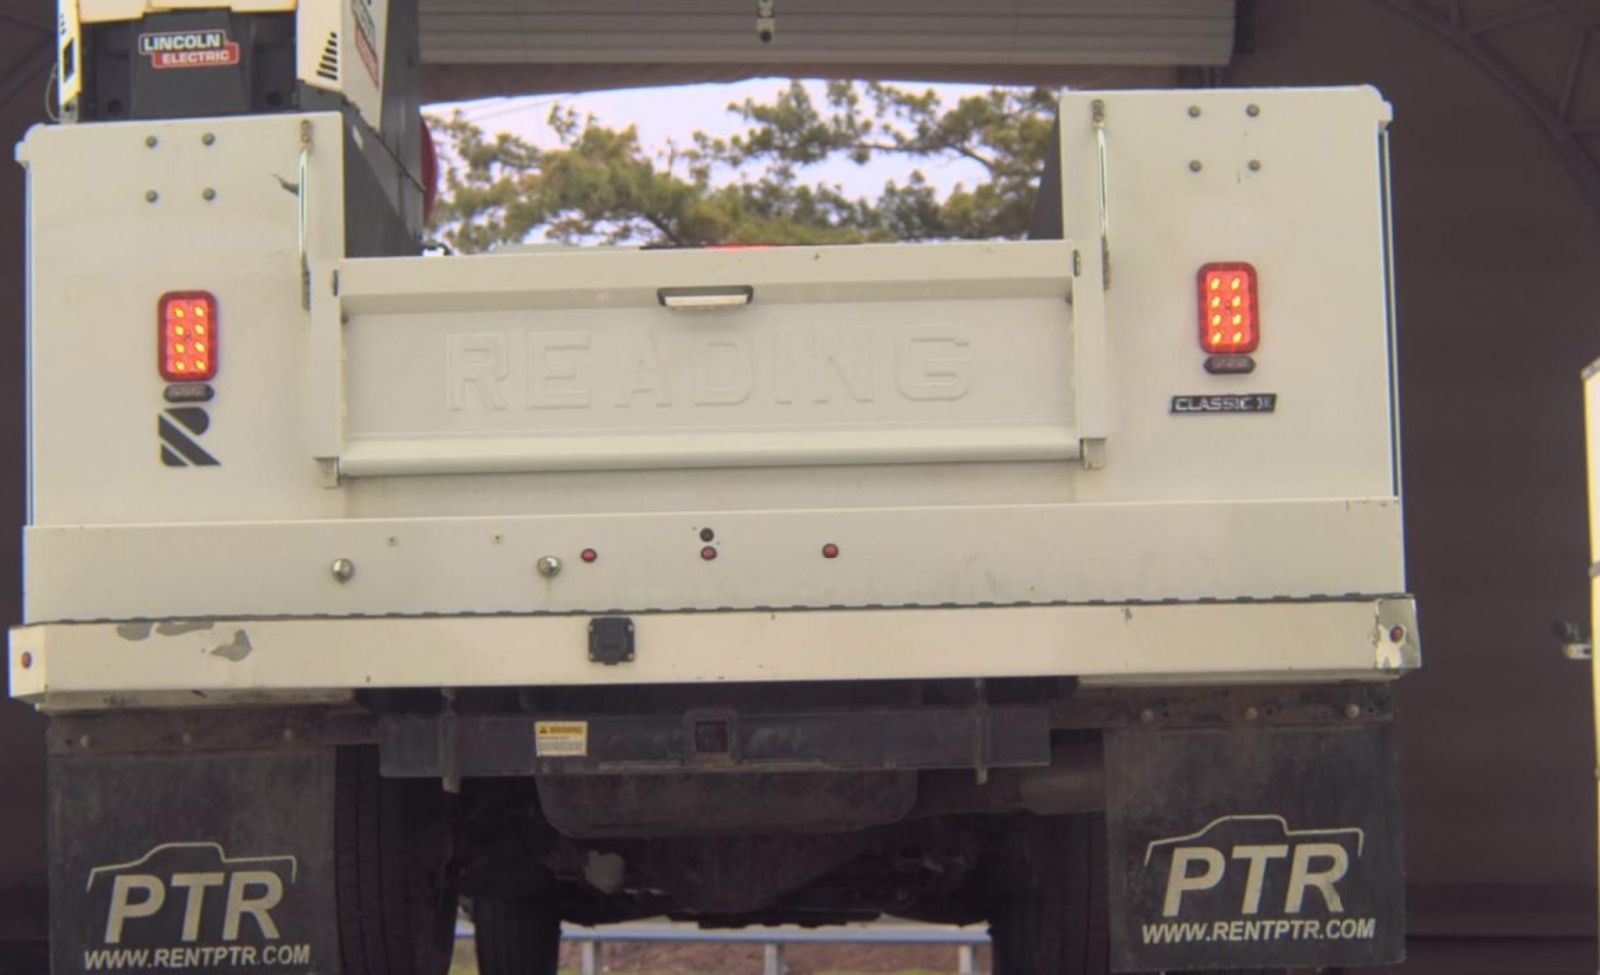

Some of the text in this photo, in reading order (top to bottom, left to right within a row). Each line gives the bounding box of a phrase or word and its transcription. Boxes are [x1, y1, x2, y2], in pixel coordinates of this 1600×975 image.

[143, 34, 221, 51] LINCOLN
[162, 50, 230, 64] ELECTRIC
[446, 322, 972, 412] READING
[1175, 397, 1253, 411] CLASSIC
[1163, 843, 1349, 917] PTR
[104, 871, 283, 944] PTR
[1142, 918, 1376, 944] WWW.RENTPTR.COM
[84, 944, 310, 970] WWW.RENTPTR.COM
